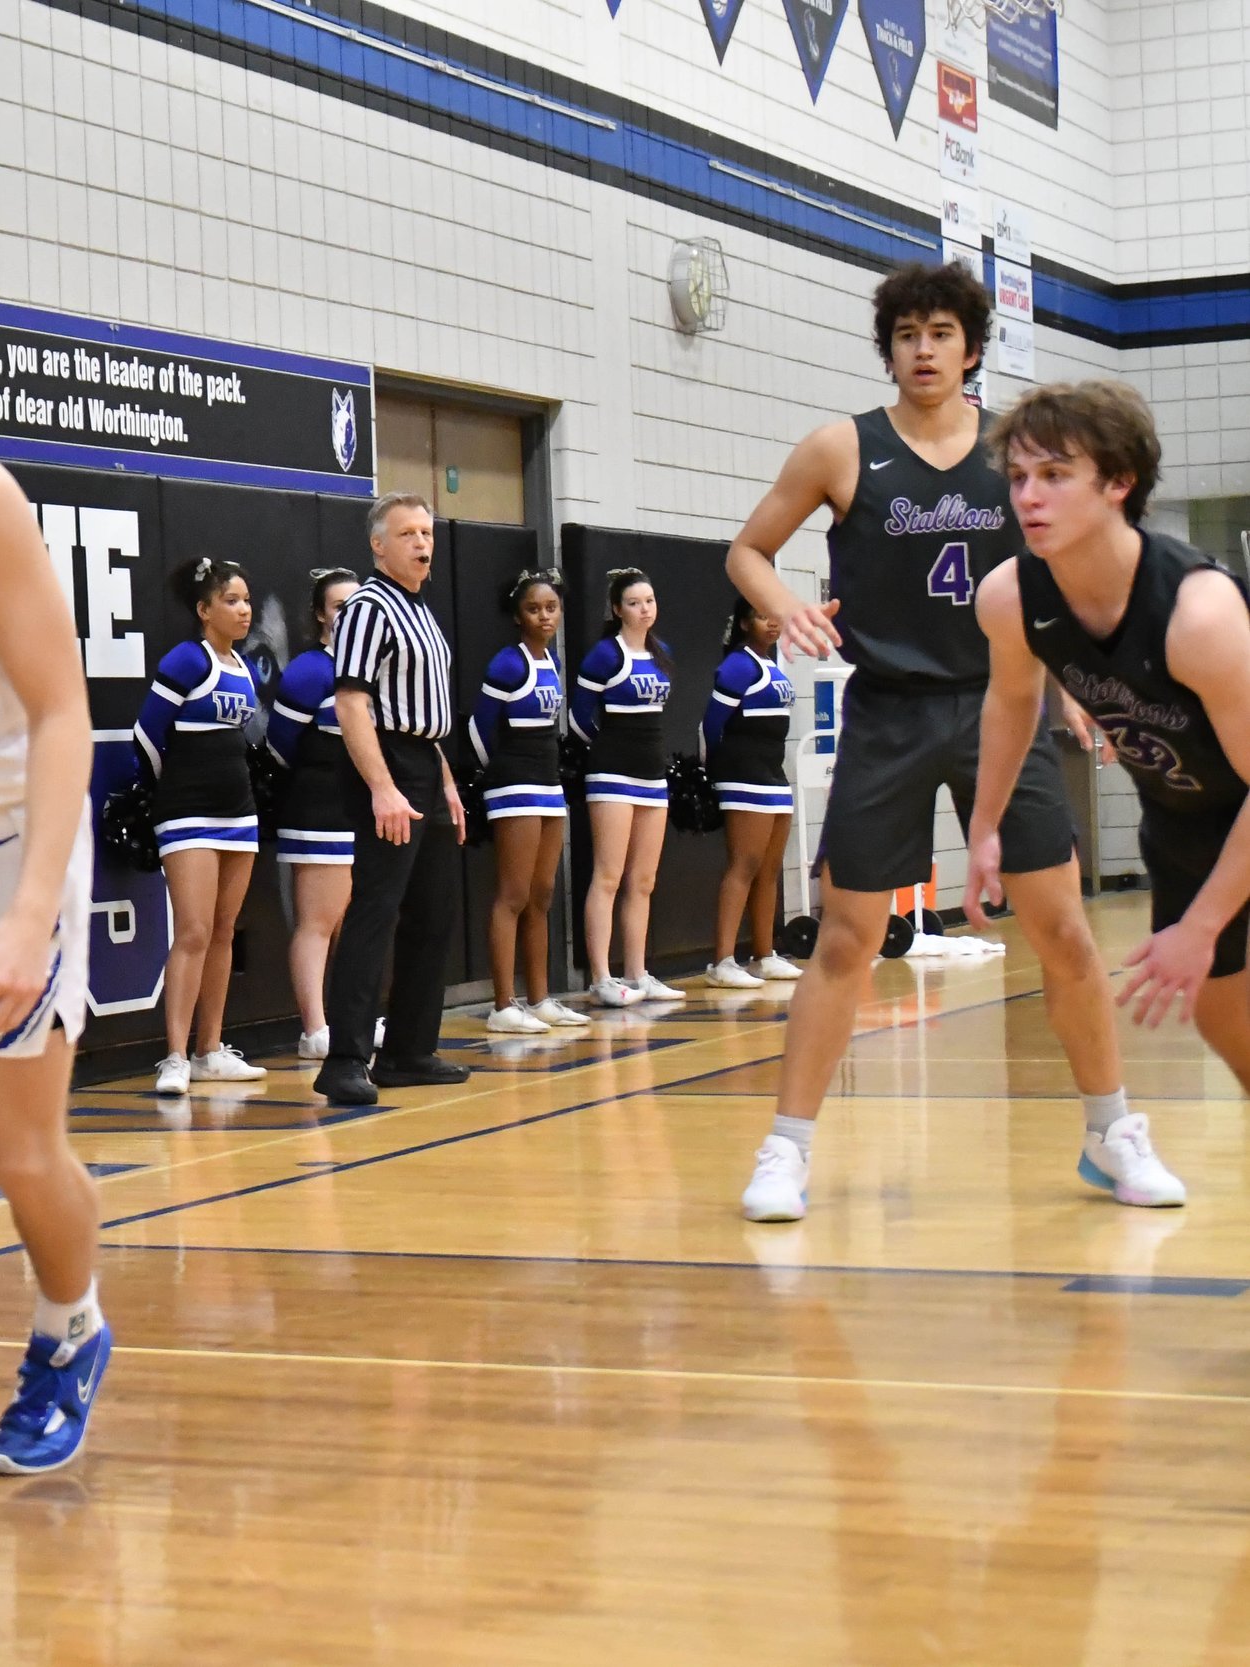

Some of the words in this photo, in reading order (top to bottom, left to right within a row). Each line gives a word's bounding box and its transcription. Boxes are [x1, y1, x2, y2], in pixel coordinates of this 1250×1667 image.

[7, 343, 38, 378] you
[42, 350, 70, 379] are
[73, 347, 101, 384] the
[104, 352, 155, 391] leader
[158, 362, 175, 394] of
[177, 365, 203, 398] the
[206, 371, 246, 407] pack.
[15, 389, 54, 426] dear
[58, 396, 84, 430] old
[87, 397, 189, 447] Worthington.
[884, 494, 1005, 535] Stallions
[927, 542, 973, 605] 4
